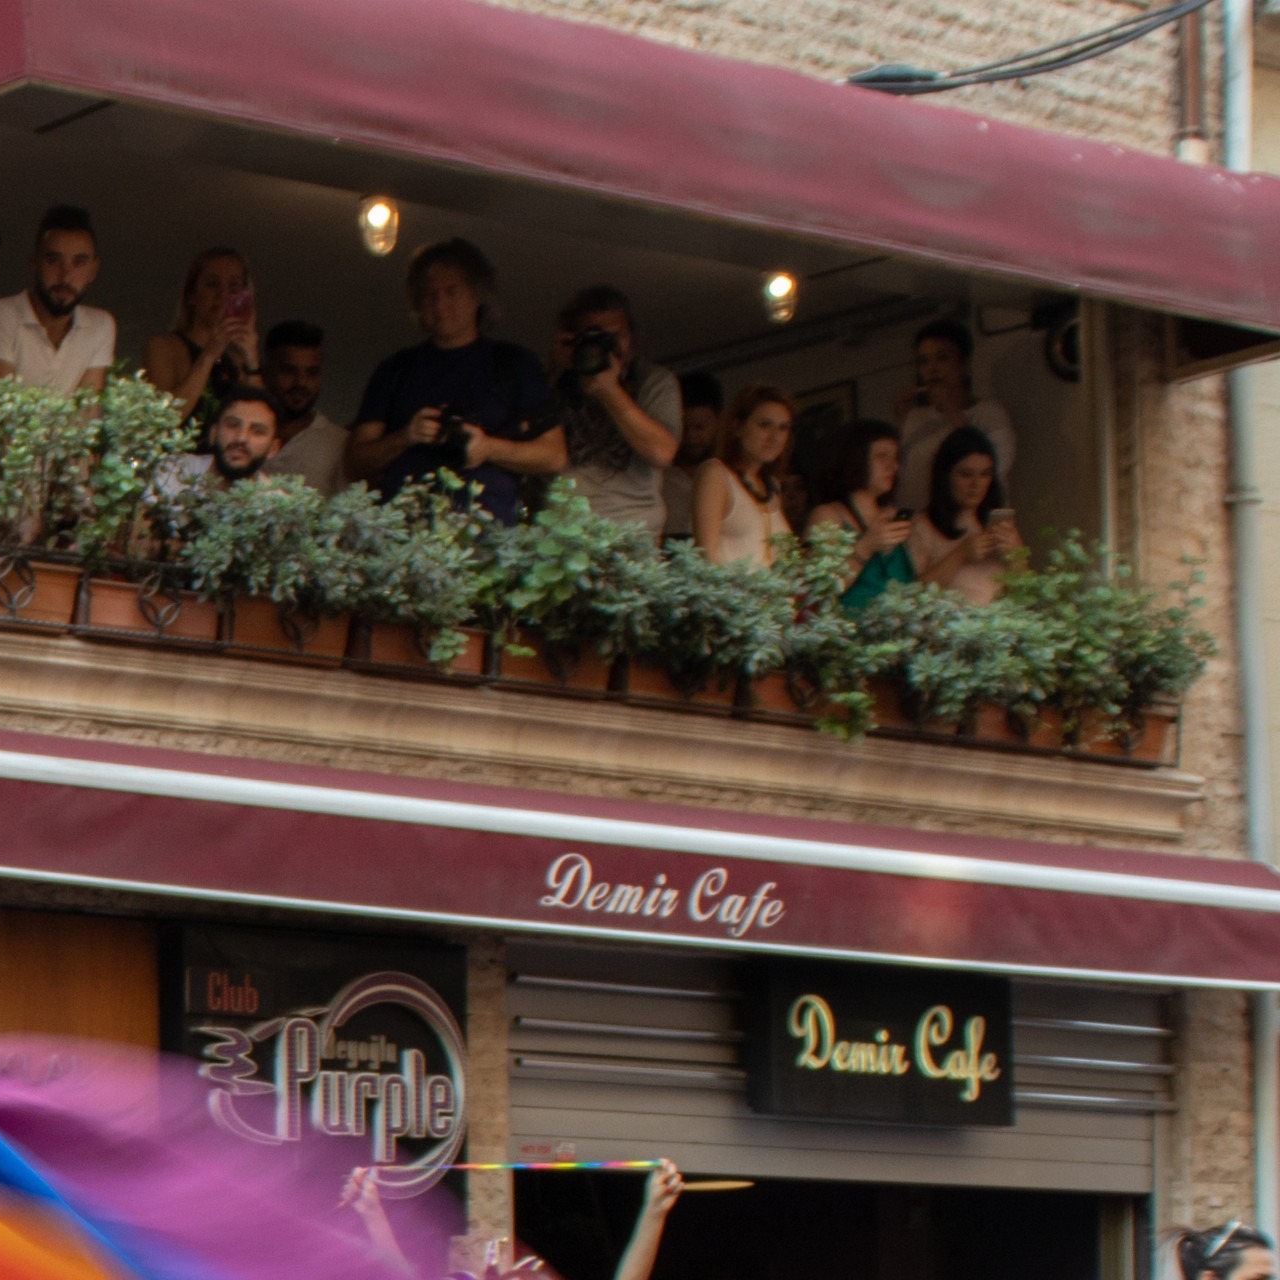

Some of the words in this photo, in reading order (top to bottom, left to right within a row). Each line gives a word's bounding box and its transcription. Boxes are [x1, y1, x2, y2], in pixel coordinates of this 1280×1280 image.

[540, 852, 680, 918] Demir
[688, 867, 787, 937] Cafe
[207, 971, 260, 1014] Club
[275, 1016, 456, 1163] Purple
[787, 993, 910, 1076] Demir
[914, 1004, 1002, 1102] Cafe
